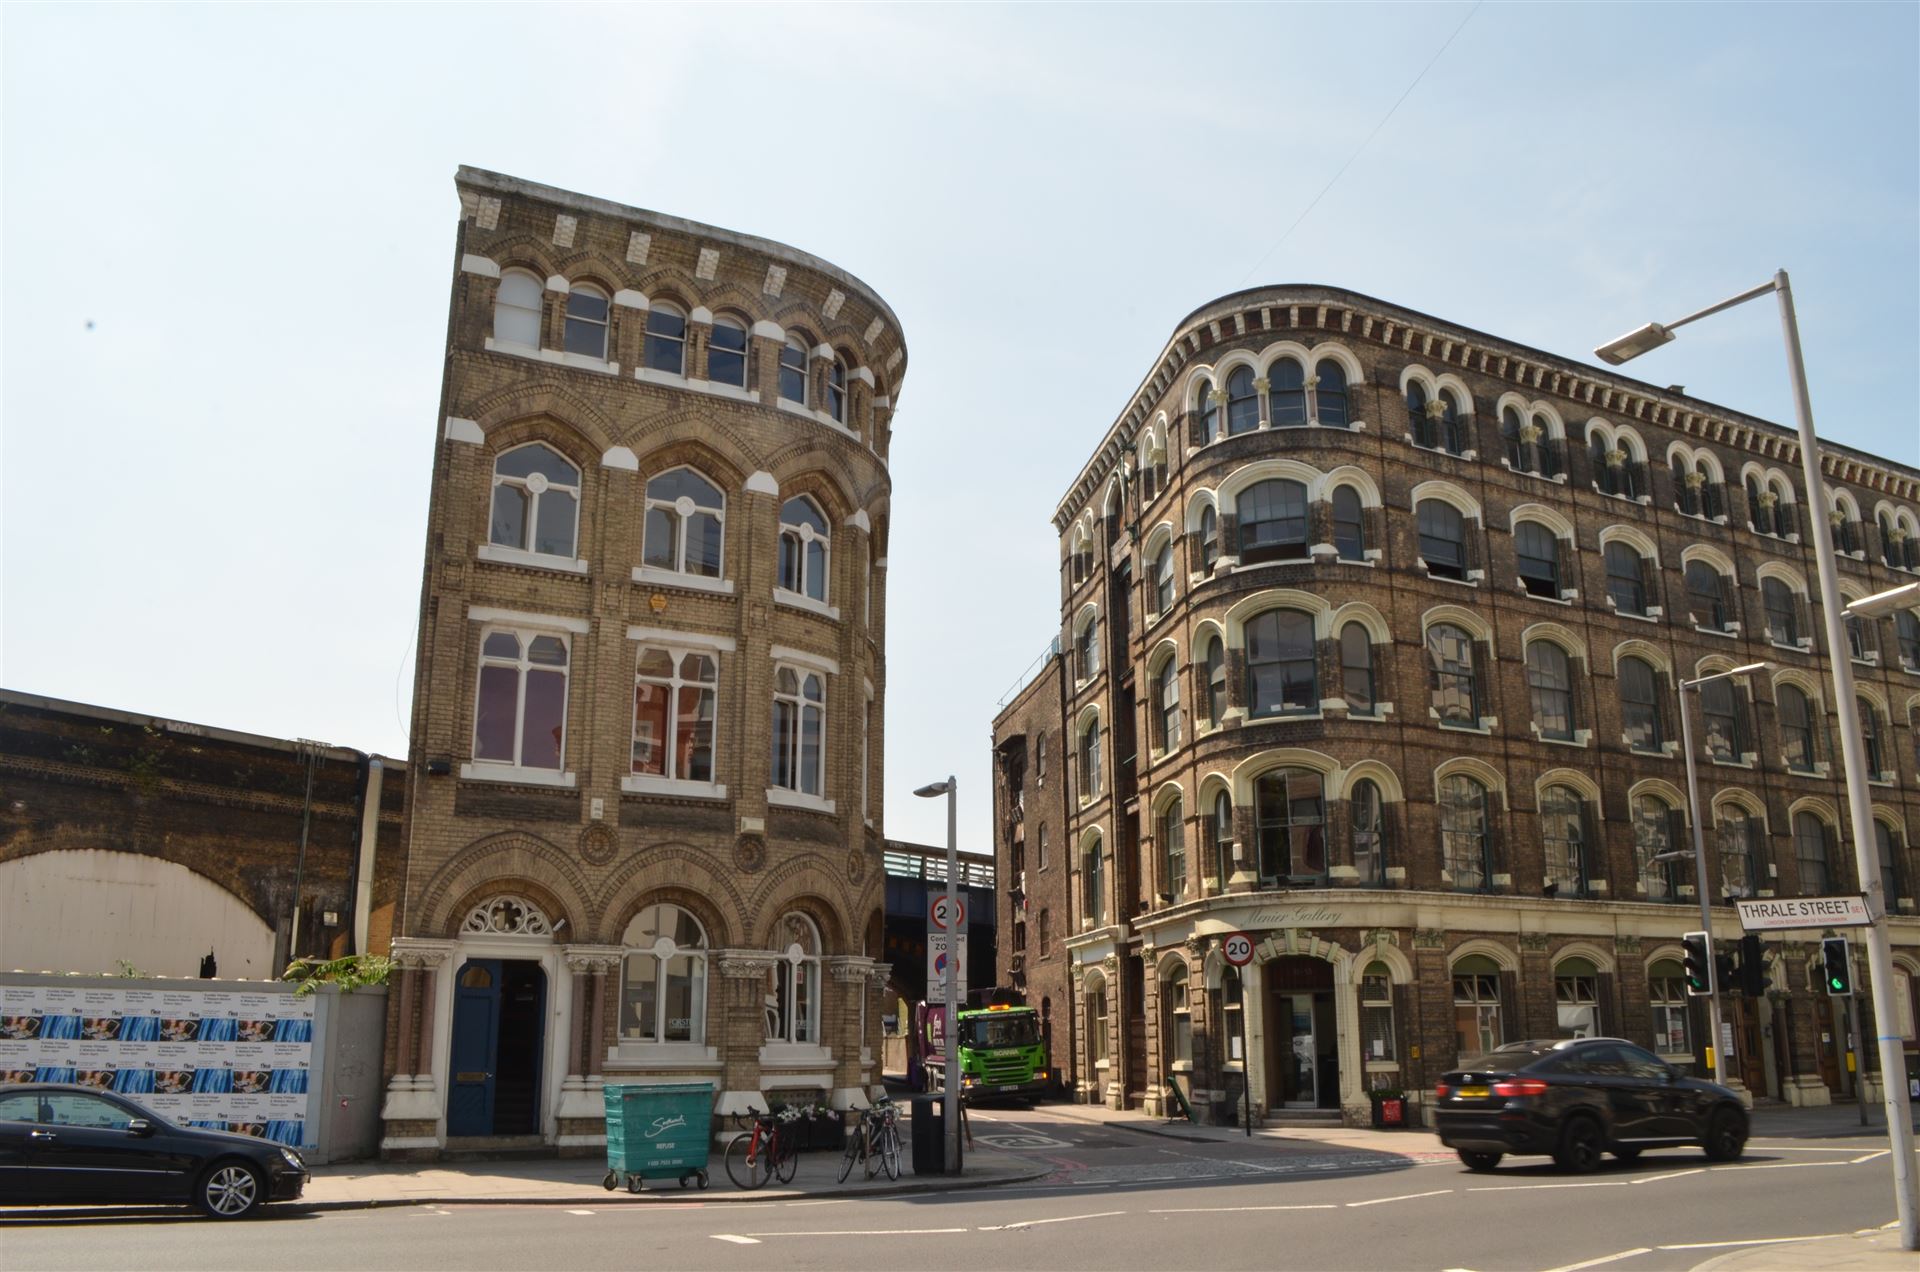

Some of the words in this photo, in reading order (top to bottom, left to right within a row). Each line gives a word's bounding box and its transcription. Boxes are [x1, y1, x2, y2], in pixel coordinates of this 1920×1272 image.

[1242, 907, 1288, 926] Menier
[1292, 904, 1343, 926] Gallery
[1741, 902, 1797, 918] THRALE
[1799, 900, 1850, 916] STREET
[1850, 905, 1864, 914] SE1
[1228, 942, 1249, 955] 20
[993, 1048, 1019, 1056] SCANIA
